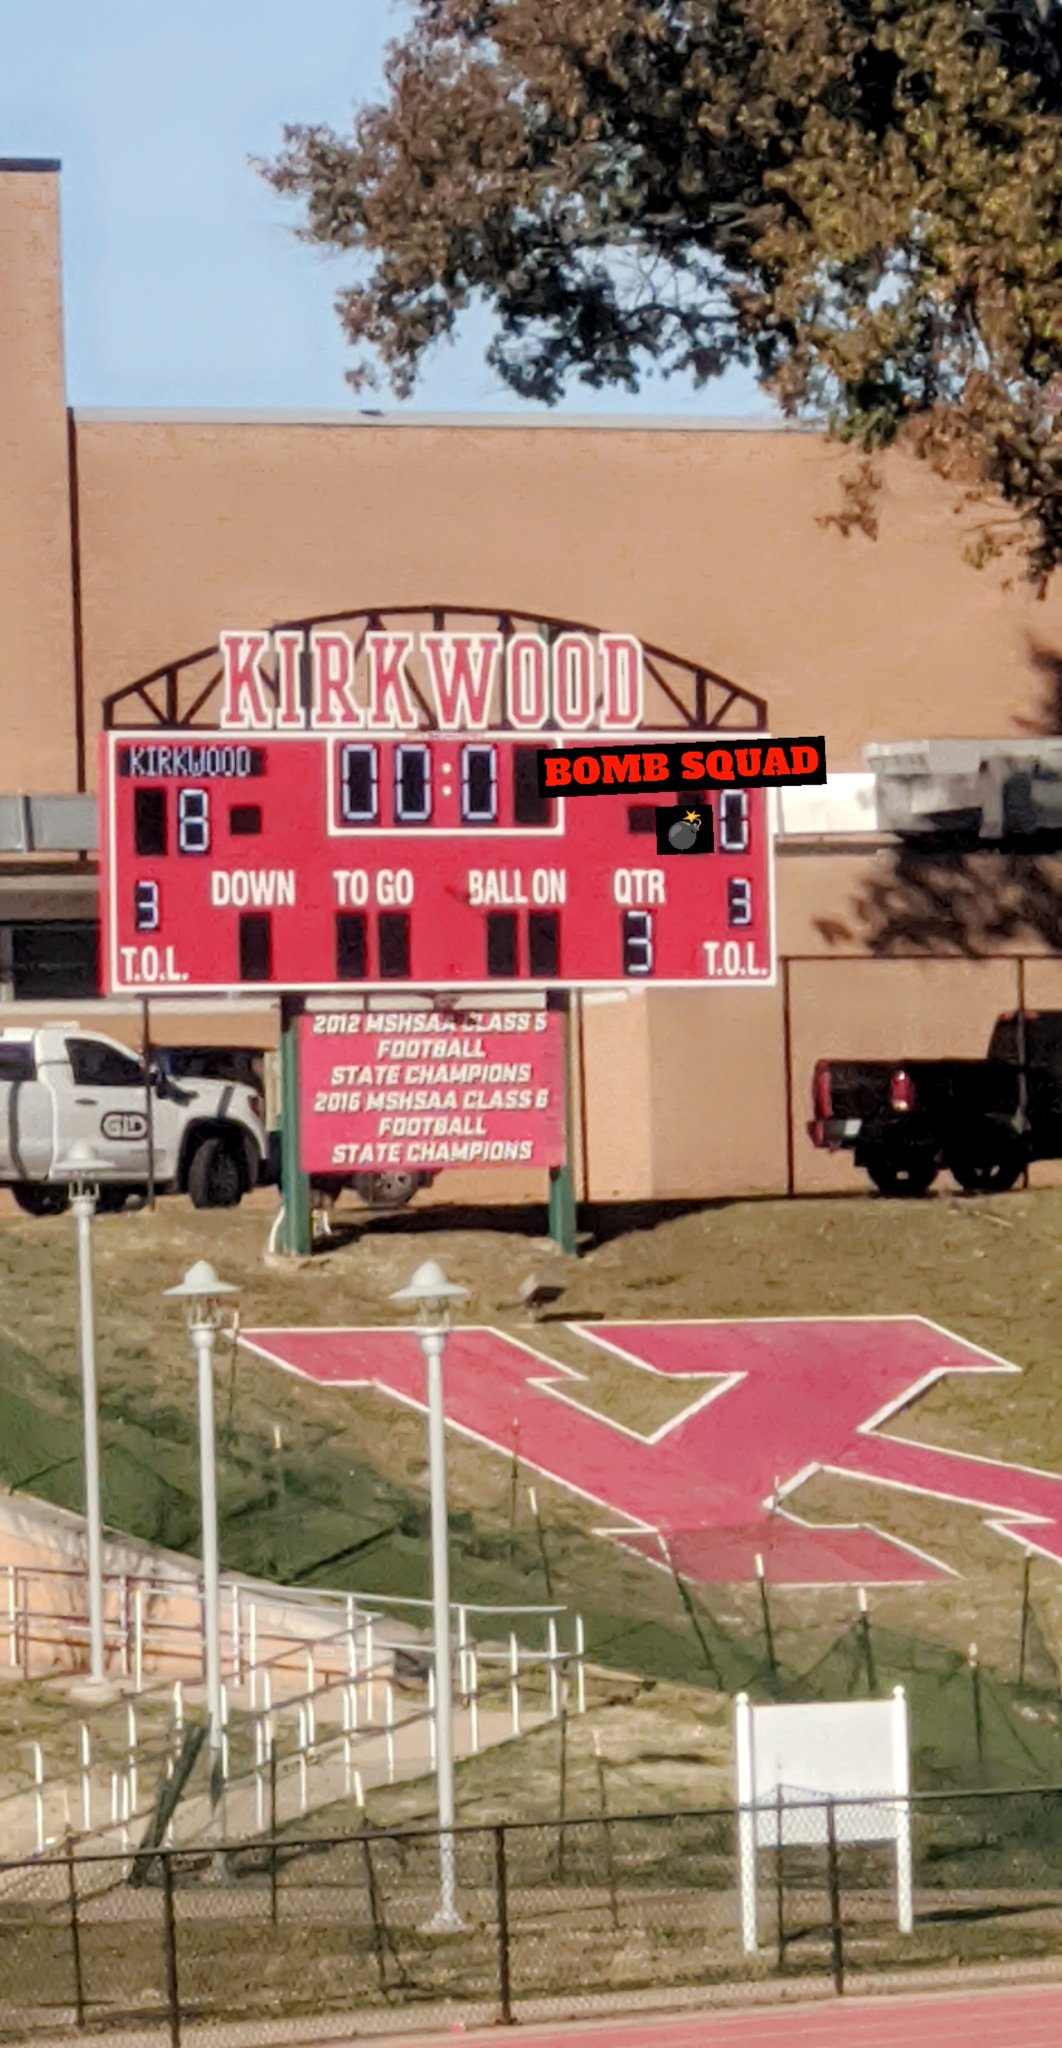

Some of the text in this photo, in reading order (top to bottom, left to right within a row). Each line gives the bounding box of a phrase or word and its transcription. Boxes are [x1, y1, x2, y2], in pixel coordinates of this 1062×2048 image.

[219, 630, 645, 731] KIRKWOOD
[128, 745, 252, 777] KIRKWOOD
[178, 788, 209, 853] 8
[719, 789, 748, 852] 0
[211, 869, 296, 906] DOWN
[332, 868, 415, 906] TO GO
[468, 868, 567, 904] BALL ON
[613, 868, 666, 904] QTR
[730, 878, 751, 924] 3
[137, 880, 160, 929] 3
[626, 910, 653, 973] 3
[704, 941, 769, 977] T.O.L.
[121, 946, 189, 982] T.O.L.
[313, 1013, 361, 1034] 2012
[364, 1012, 456, 1033] MSHSAA
[377, 1038, 486, 1060] FOOTBALL
[331, 1063, 532, 1085] STATE CHAMPIONS
[314, 1088, 549, 1112] 2016 MSHSAA CLASS 6
[377, 1116, 487, 1137] FOOTBALL
[332, 1141, 534, 1164] STATE CHAMPIONS
